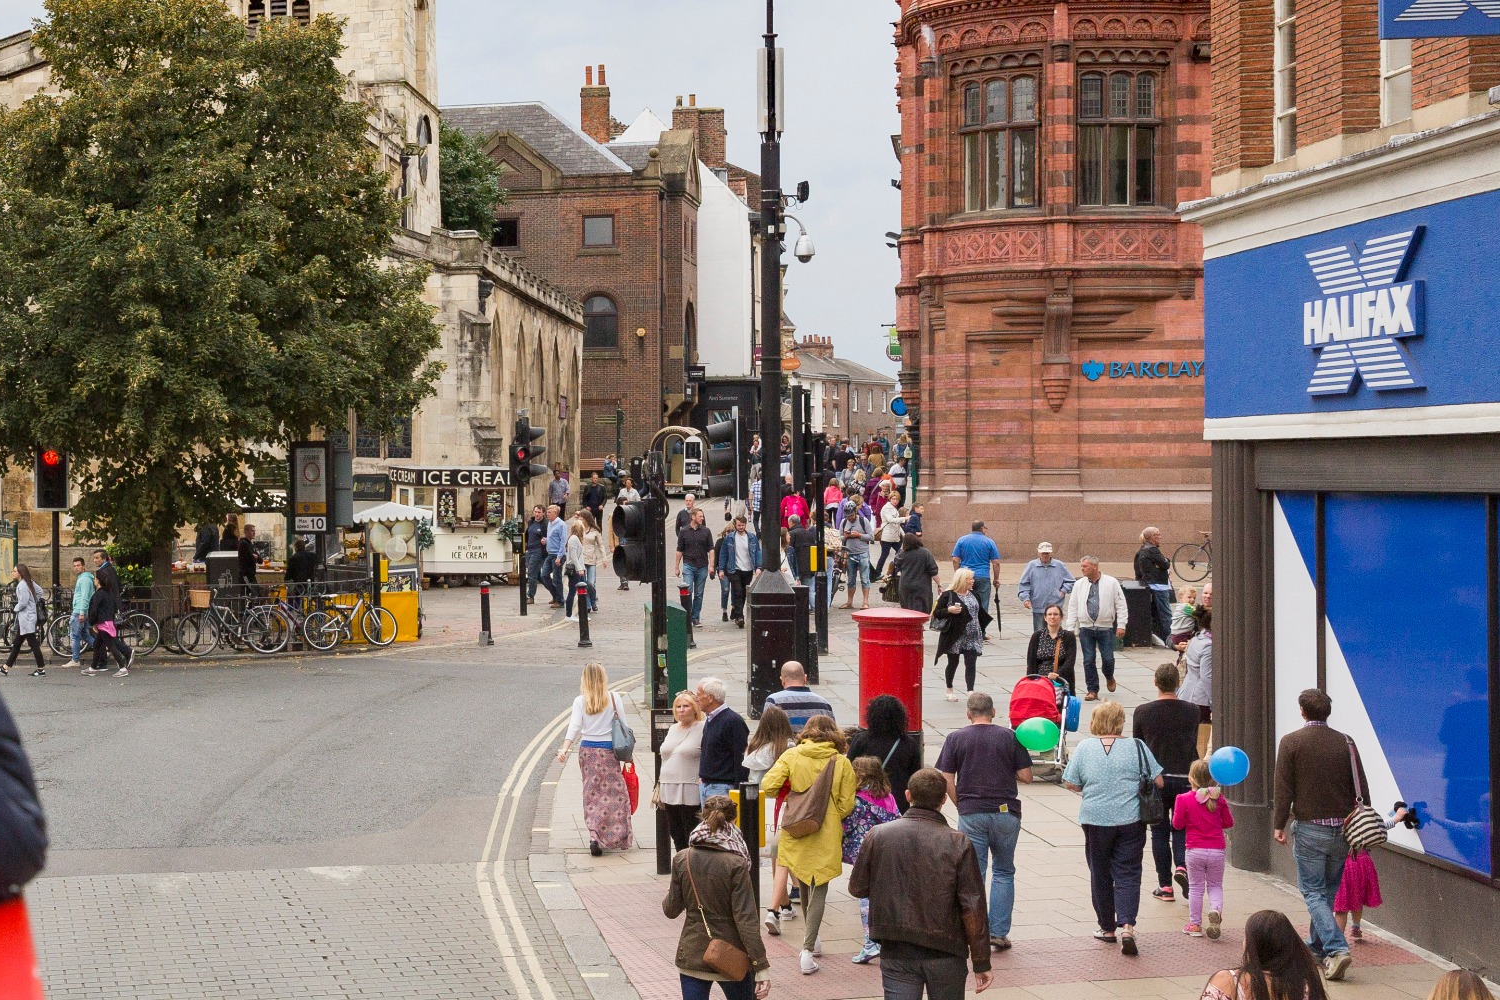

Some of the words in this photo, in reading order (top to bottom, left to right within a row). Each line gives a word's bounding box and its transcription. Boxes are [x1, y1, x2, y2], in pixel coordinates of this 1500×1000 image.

[1303, 284, 1414, 346] HALIFAX
[1108, 361, 1205, 379] BARCLAY
[422, 471, 451, 485] ICE
[310, 517, 325, 530] 10
[451, 551, 462, 560] ICE
[465, 551, 488, 560] CREAM
